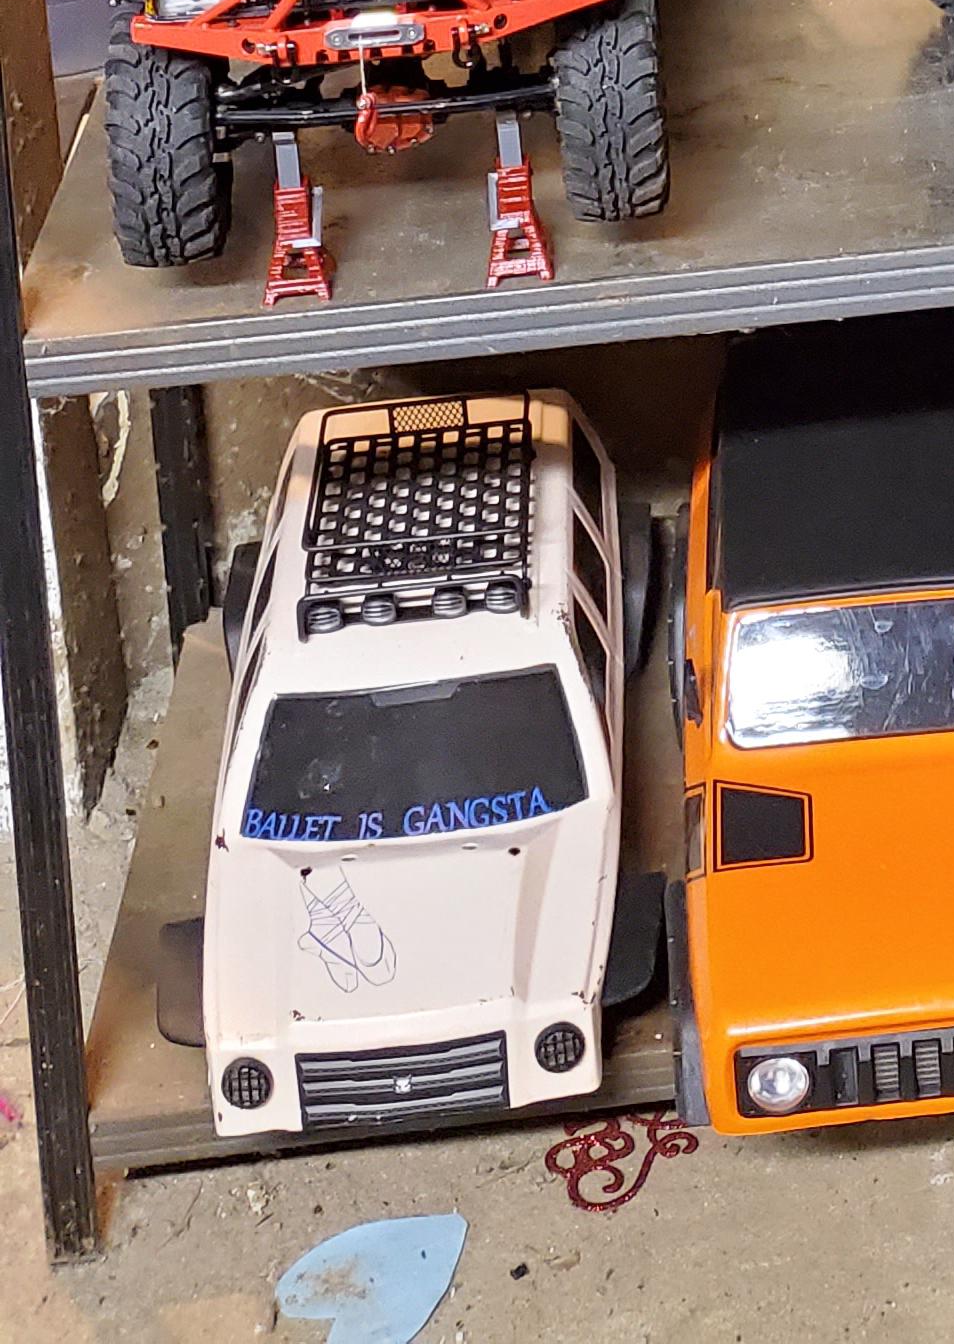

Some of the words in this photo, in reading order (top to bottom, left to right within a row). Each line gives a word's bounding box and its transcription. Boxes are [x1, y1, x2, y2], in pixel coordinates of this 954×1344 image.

[244, 808, 342, 841] BALLET
[357, 811, 384, 840] IS
[402, 785, 551, 836] GANGSTA
